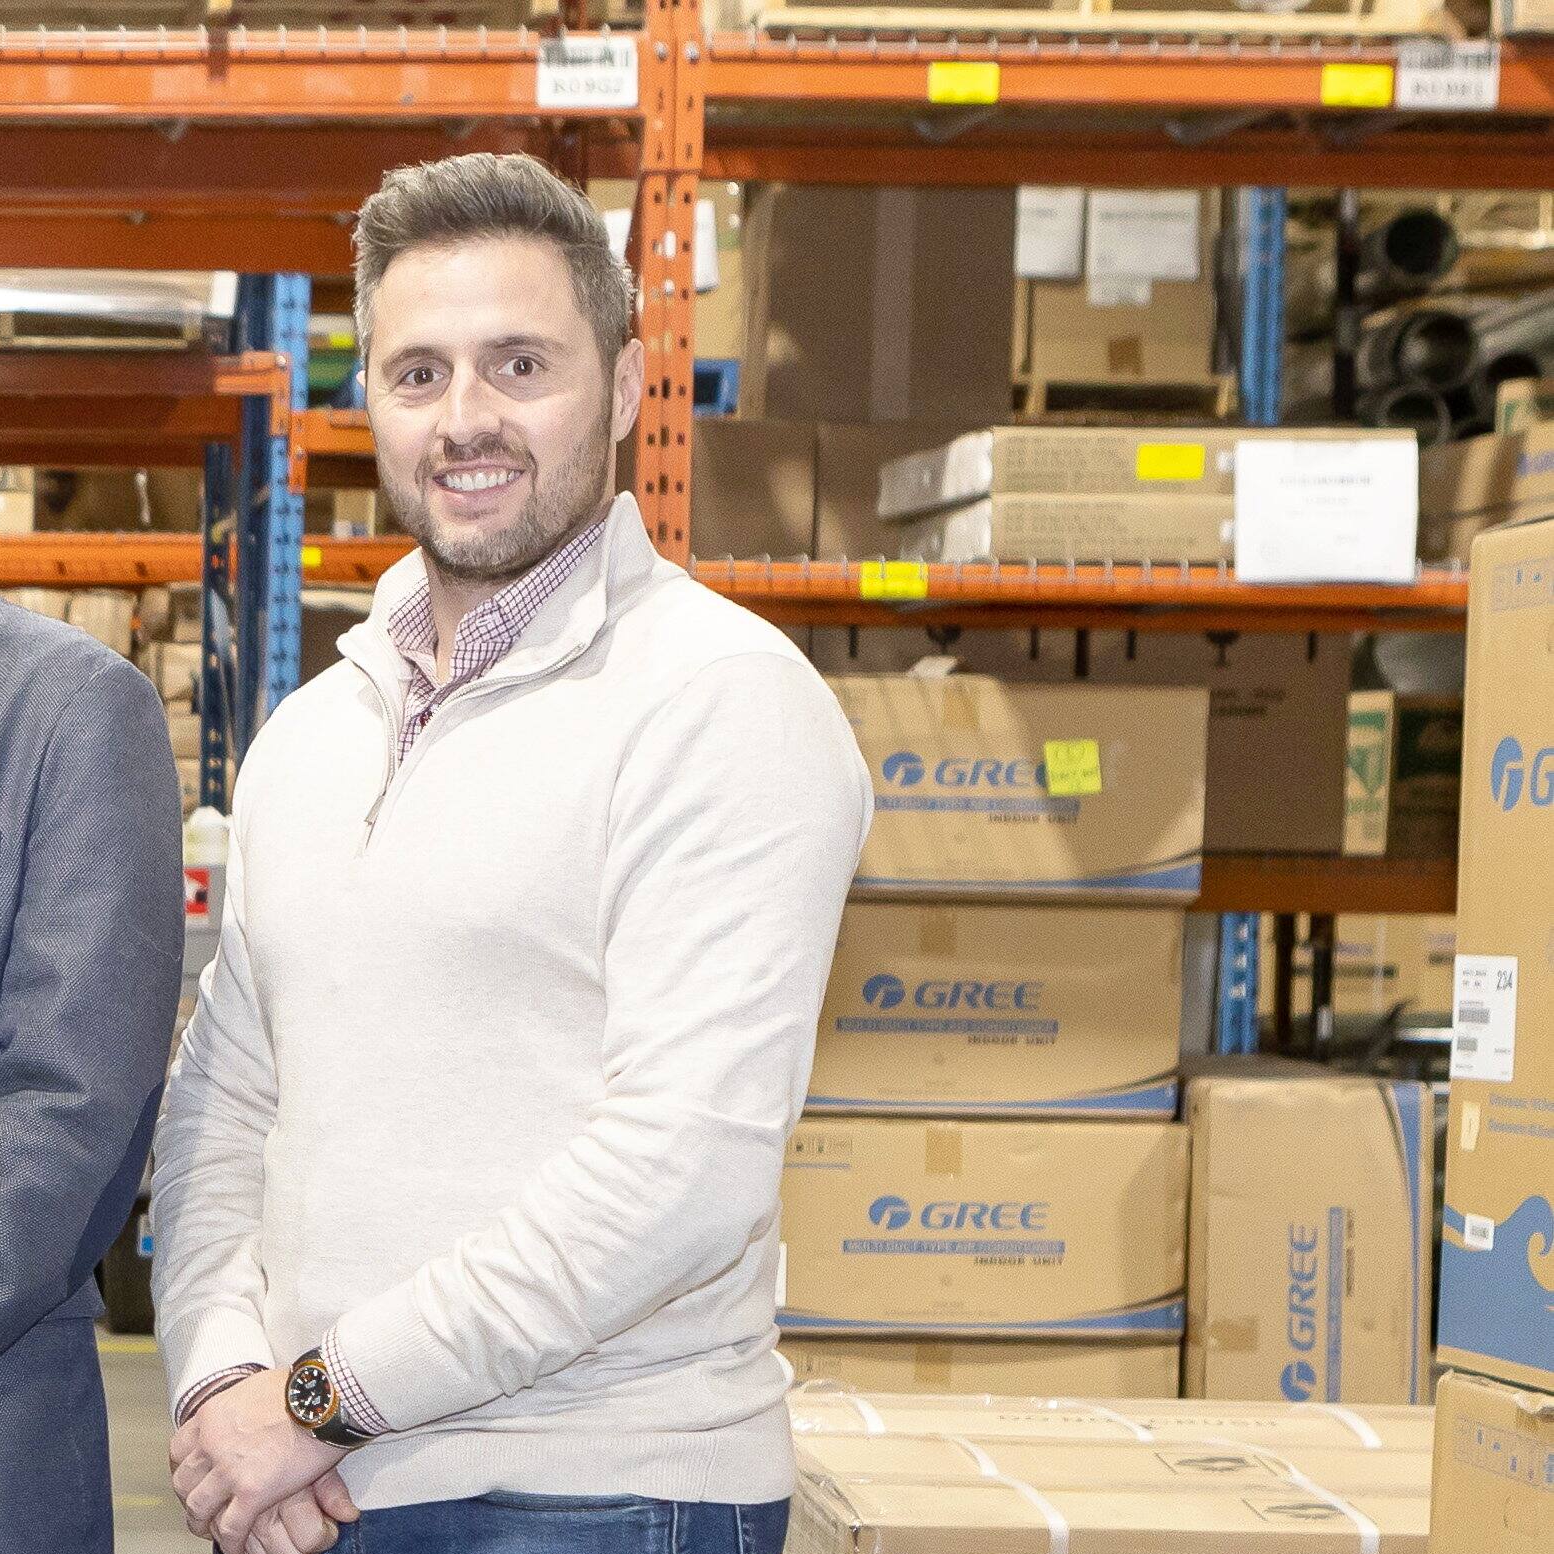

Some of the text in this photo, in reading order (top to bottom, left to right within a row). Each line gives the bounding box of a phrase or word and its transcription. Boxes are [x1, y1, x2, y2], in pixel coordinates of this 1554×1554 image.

[914, 980, 1044, 1011] GREE
[920, 1201, 1051, 1231] GREE
[1288, 1222, 1319, 1352] GREE
